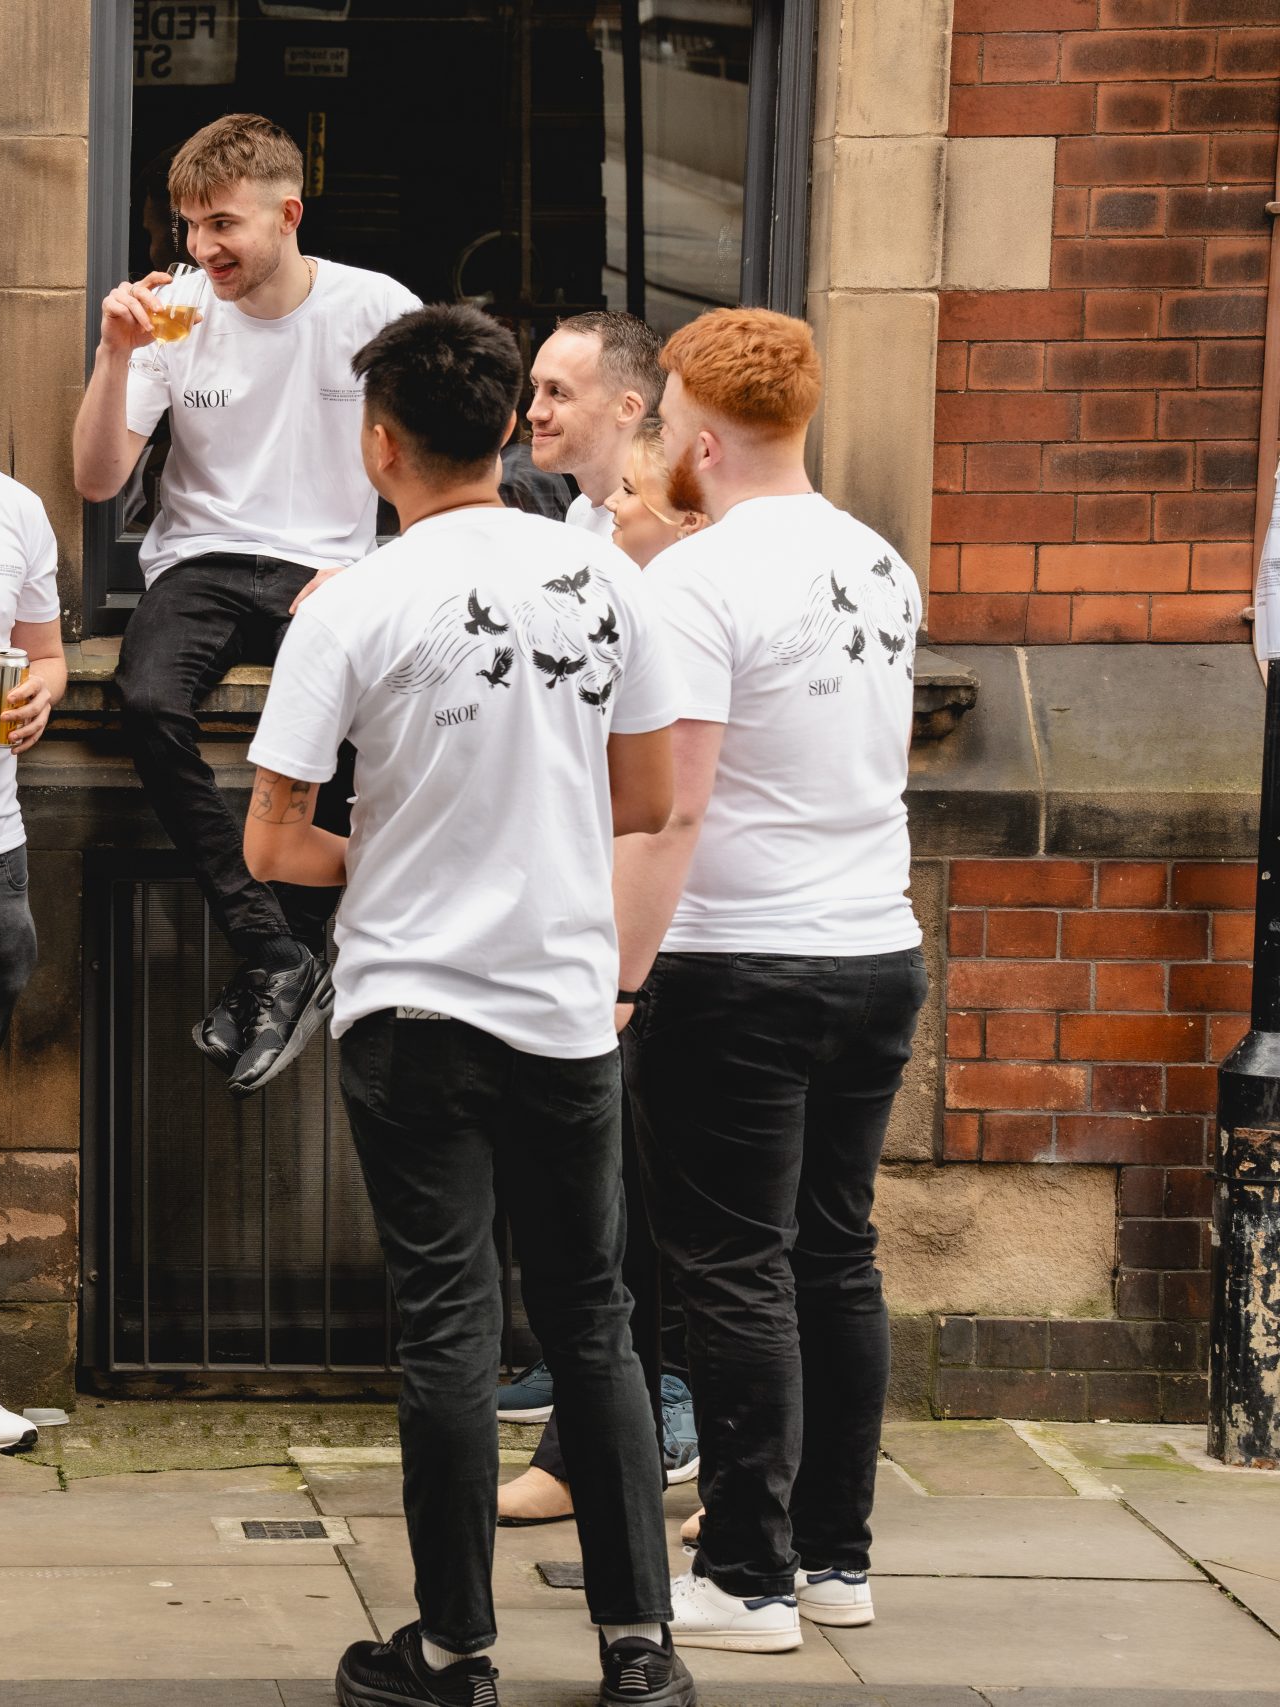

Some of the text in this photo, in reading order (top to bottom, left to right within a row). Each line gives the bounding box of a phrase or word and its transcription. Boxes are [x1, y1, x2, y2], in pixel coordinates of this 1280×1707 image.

[183, 389, 232, 408] SKOF
[808, 676, 843, 696] SKOF
[434, 704, 479, 727] SKOF
